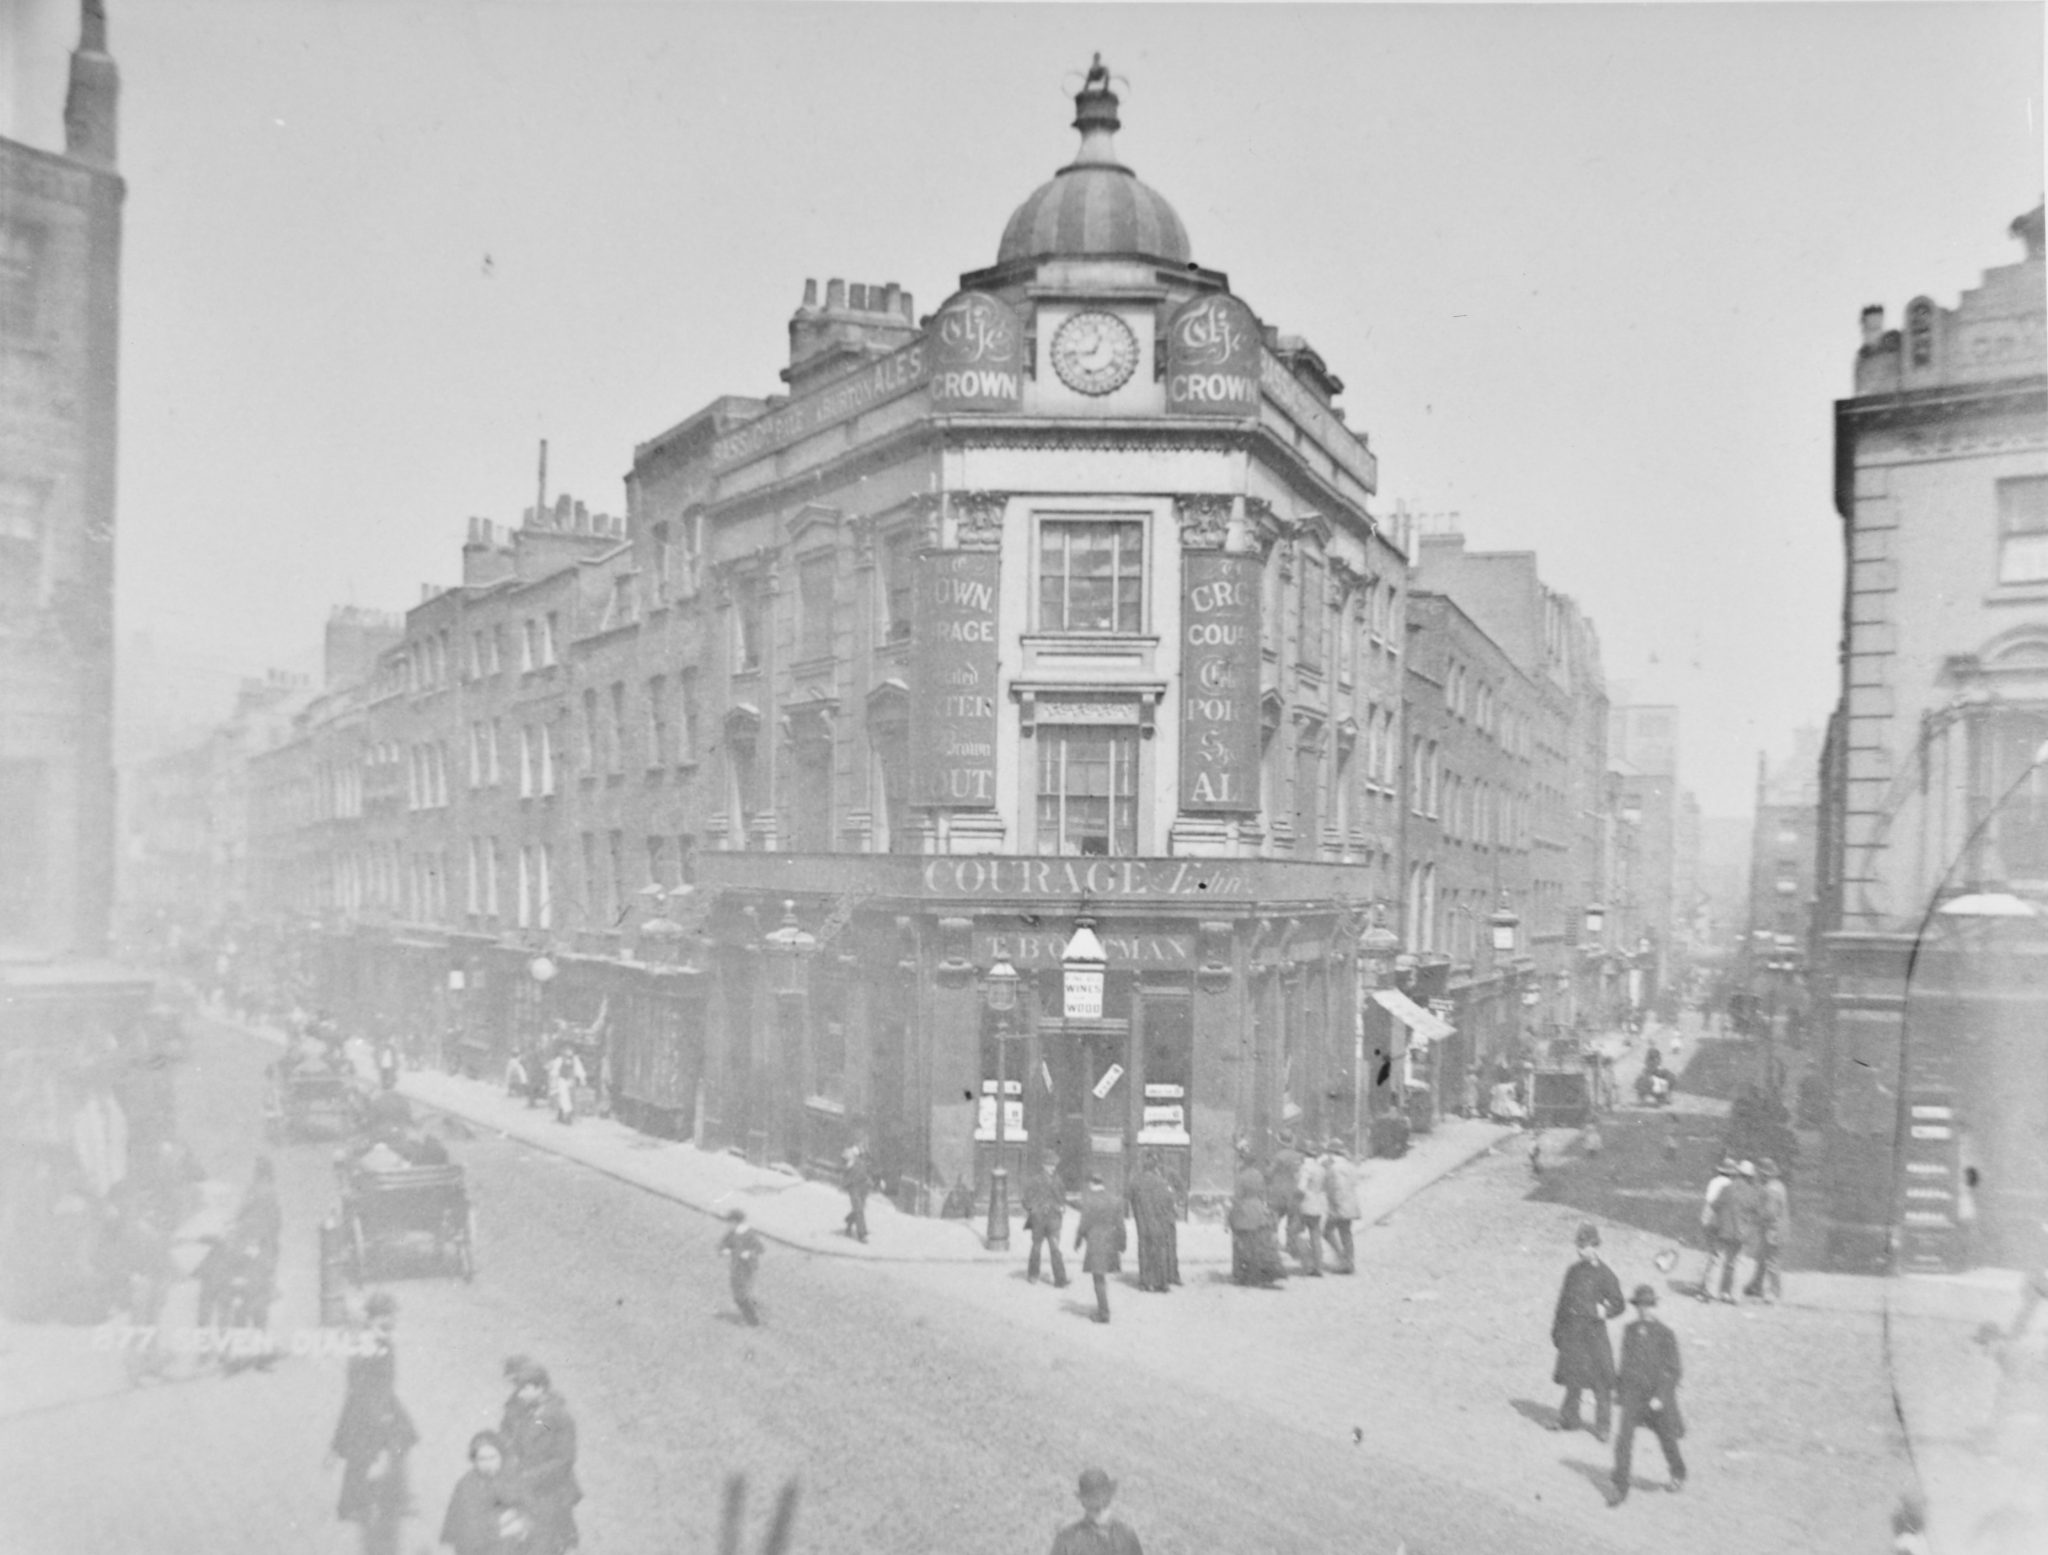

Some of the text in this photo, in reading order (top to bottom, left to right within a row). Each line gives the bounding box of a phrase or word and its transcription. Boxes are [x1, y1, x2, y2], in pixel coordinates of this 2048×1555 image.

[873, 347, 922, 398] ALES
[931, 370, 1018, 400] CROWN
[1171, 374, 1260, 402] CROWN
[925, 859, 1148, 895] COURAGE
